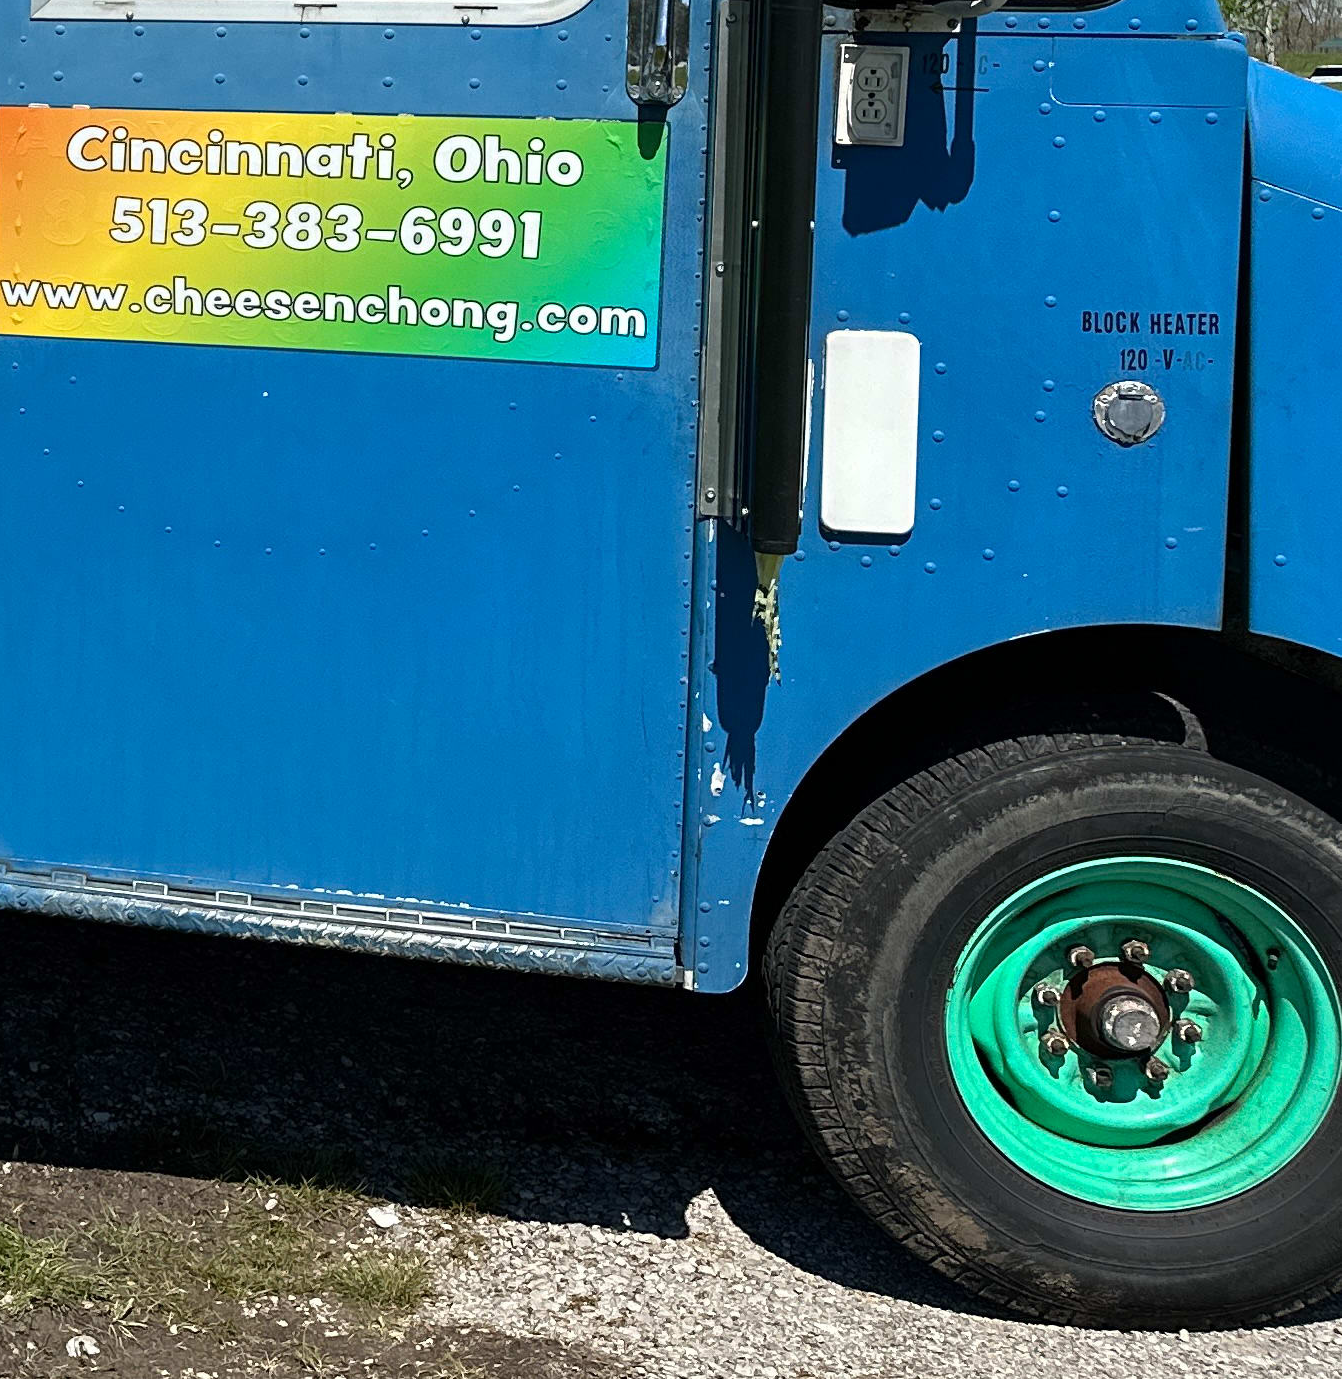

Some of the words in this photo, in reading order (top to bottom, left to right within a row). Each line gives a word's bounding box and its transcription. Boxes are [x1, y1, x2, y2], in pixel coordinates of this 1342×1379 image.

[66, 125, 415, 189] Cincinnati,
[432, 133, 585, 188] Ohio
[108, 195, 543, 260] 513-383-6991
[0, 275, 649, 343] www.cheesenchong.com
[1082, 311, 1140, 334] BLOCK
[1150, 313, 1220, 335] HEATER
[1120, 349, 1148, 371] 120
